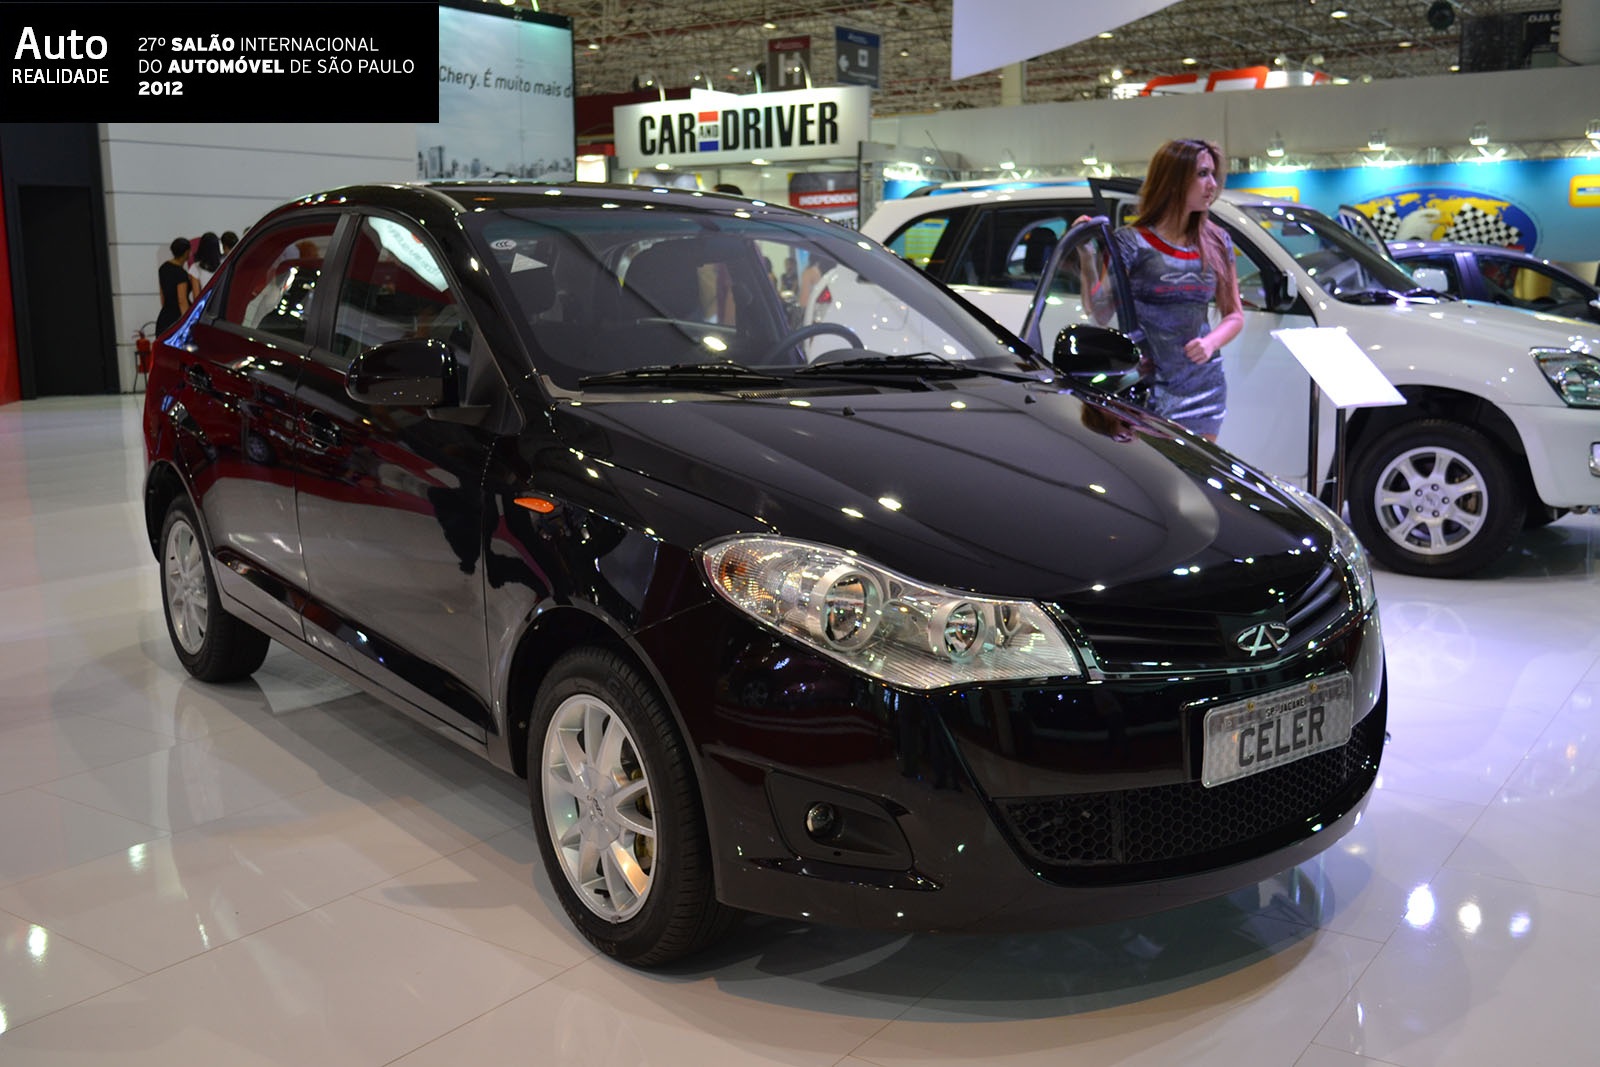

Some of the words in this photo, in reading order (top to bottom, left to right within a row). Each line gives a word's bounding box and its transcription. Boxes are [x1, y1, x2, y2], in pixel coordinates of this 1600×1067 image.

[484, 68, 492, 88] É
[495, 76, 531, 93] muito
[533, 81, 561, 97] mais
[639, 113, 697, 156] CAR
[699, 124, 719, 139] AND
[722, 101, 839, 151] DRIVER
[1239, 705, 1325, 768] CELER
